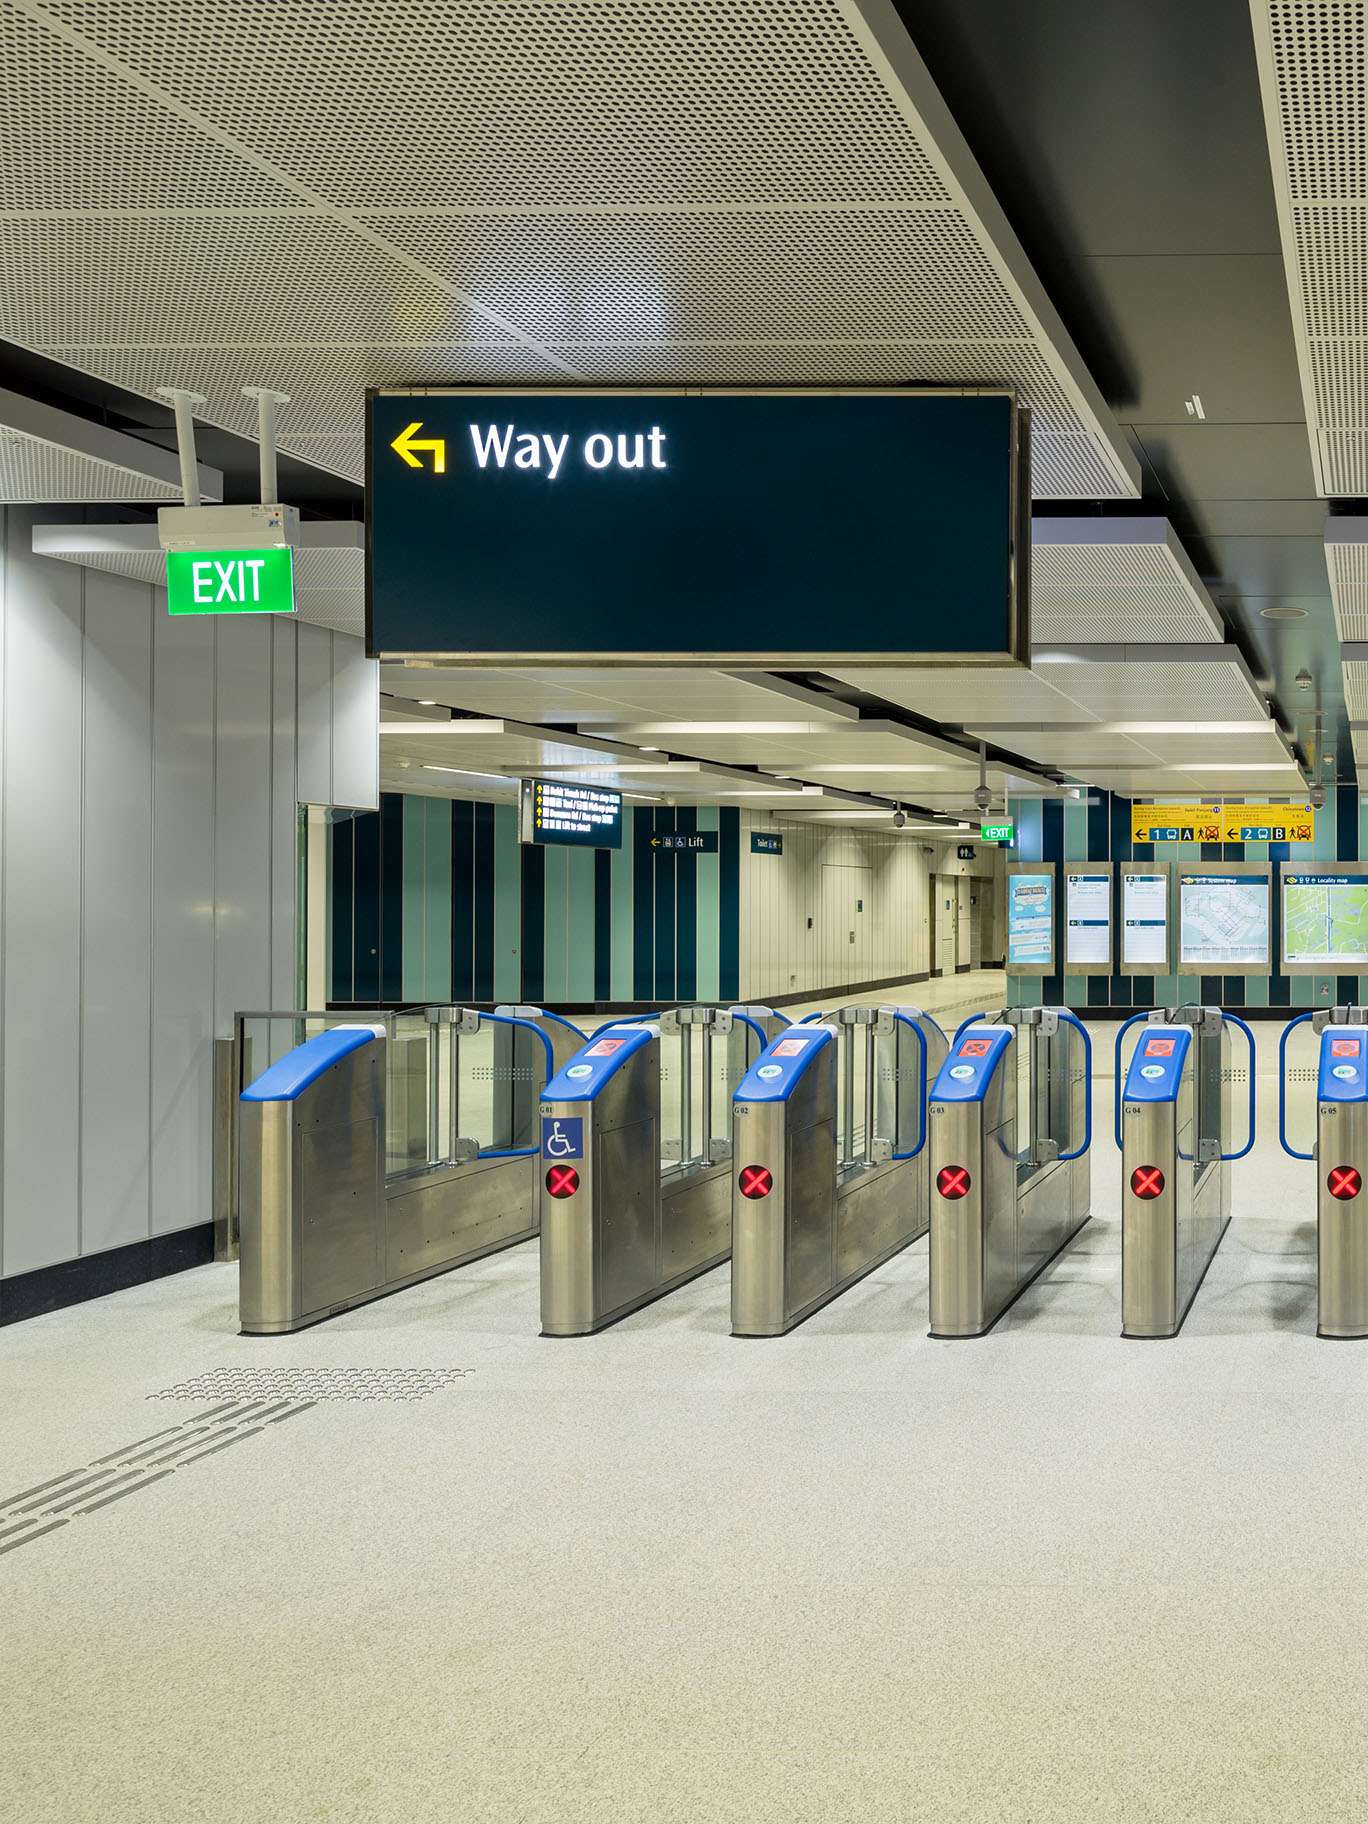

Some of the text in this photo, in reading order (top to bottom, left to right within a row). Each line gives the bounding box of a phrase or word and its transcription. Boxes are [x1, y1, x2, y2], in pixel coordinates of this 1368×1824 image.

[469, 424, 667, 480] Way out
[192, 560, 265, 603] EXIT
[990, 827, 1010, 838] EXIT
[1154, 829, 1160, 840] 1
[1183, 829, 1192, 840] A
[1244, 829, 1252, 840] 2
[1275, 829, 1283, 839] B
[688, 837, 704, 847] Lift
[540, 1106, 552, 1114] G 01
